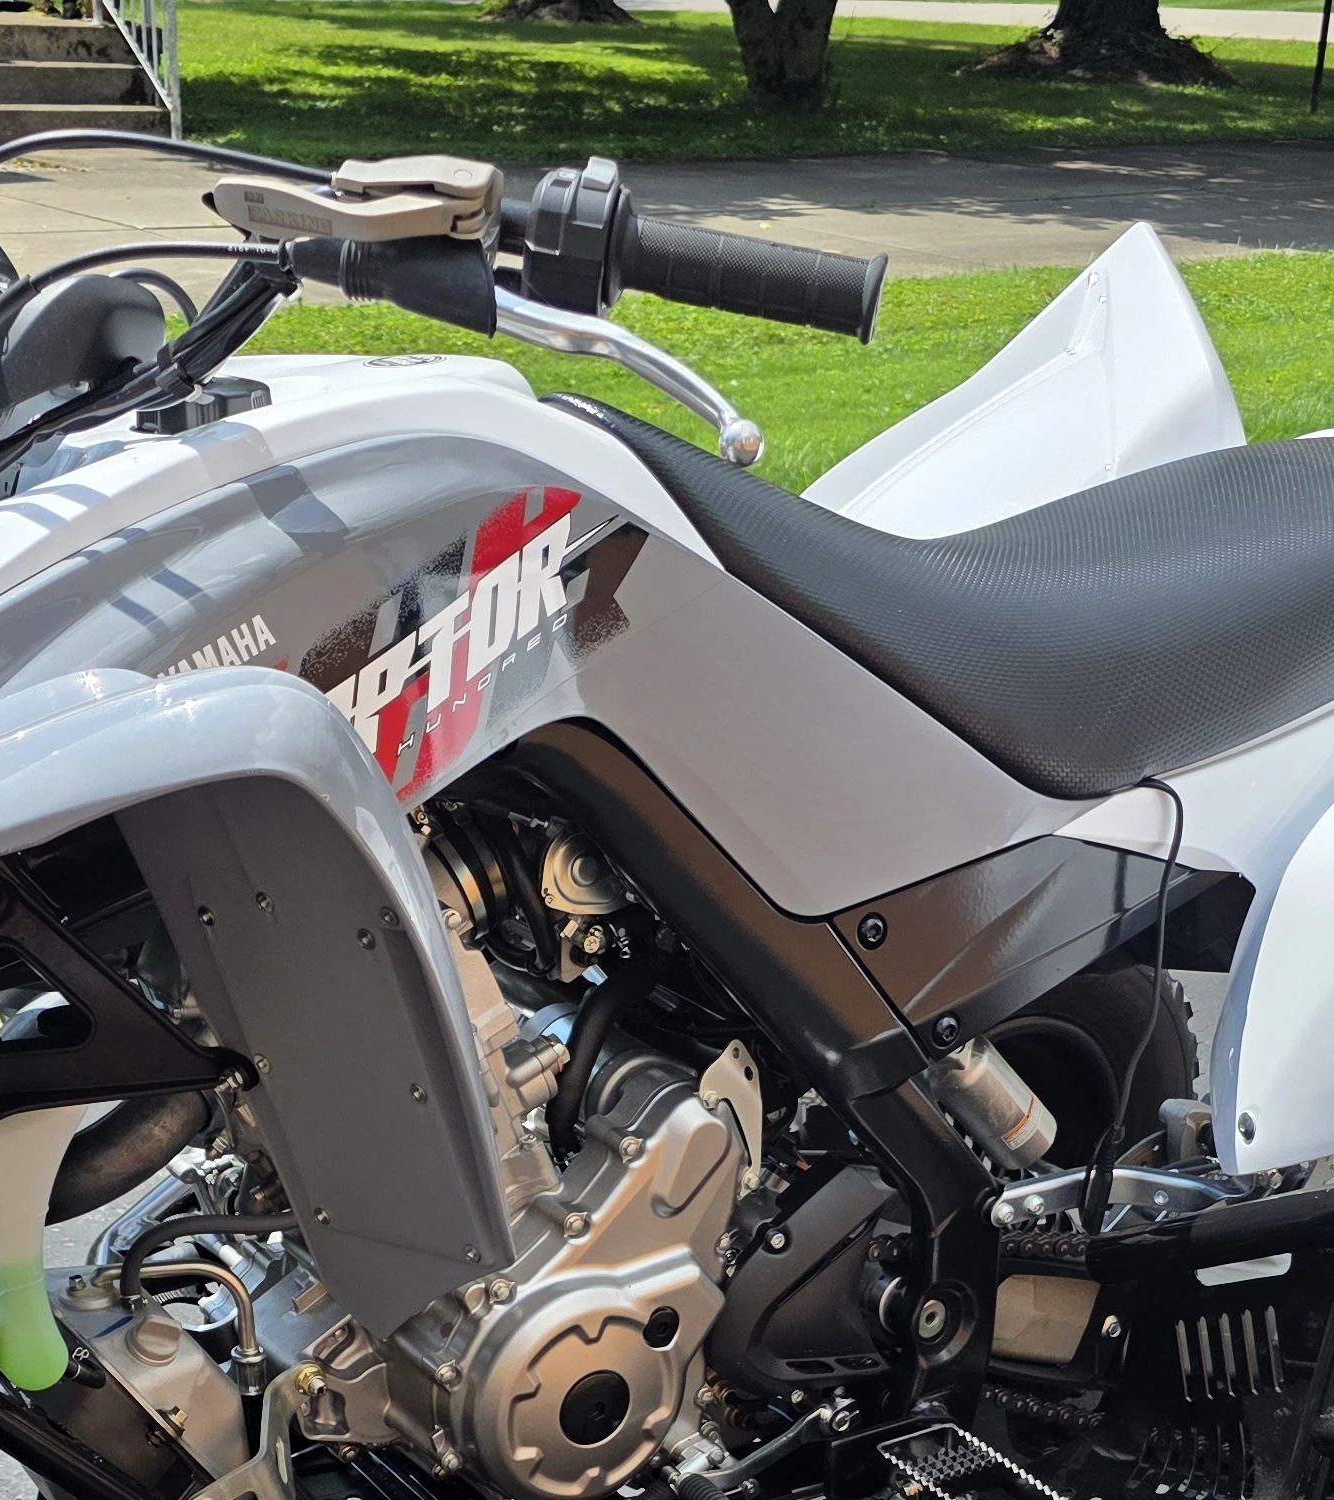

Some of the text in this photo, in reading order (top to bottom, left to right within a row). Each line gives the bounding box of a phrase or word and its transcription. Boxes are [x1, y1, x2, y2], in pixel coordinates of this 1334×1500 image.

[249, 205, 332, 236] PARKING
[157, 614, 276, 679] MAHA
[323, 512, 619, 755] PTOR
[397, 614, 567, 756] HUNDRED
